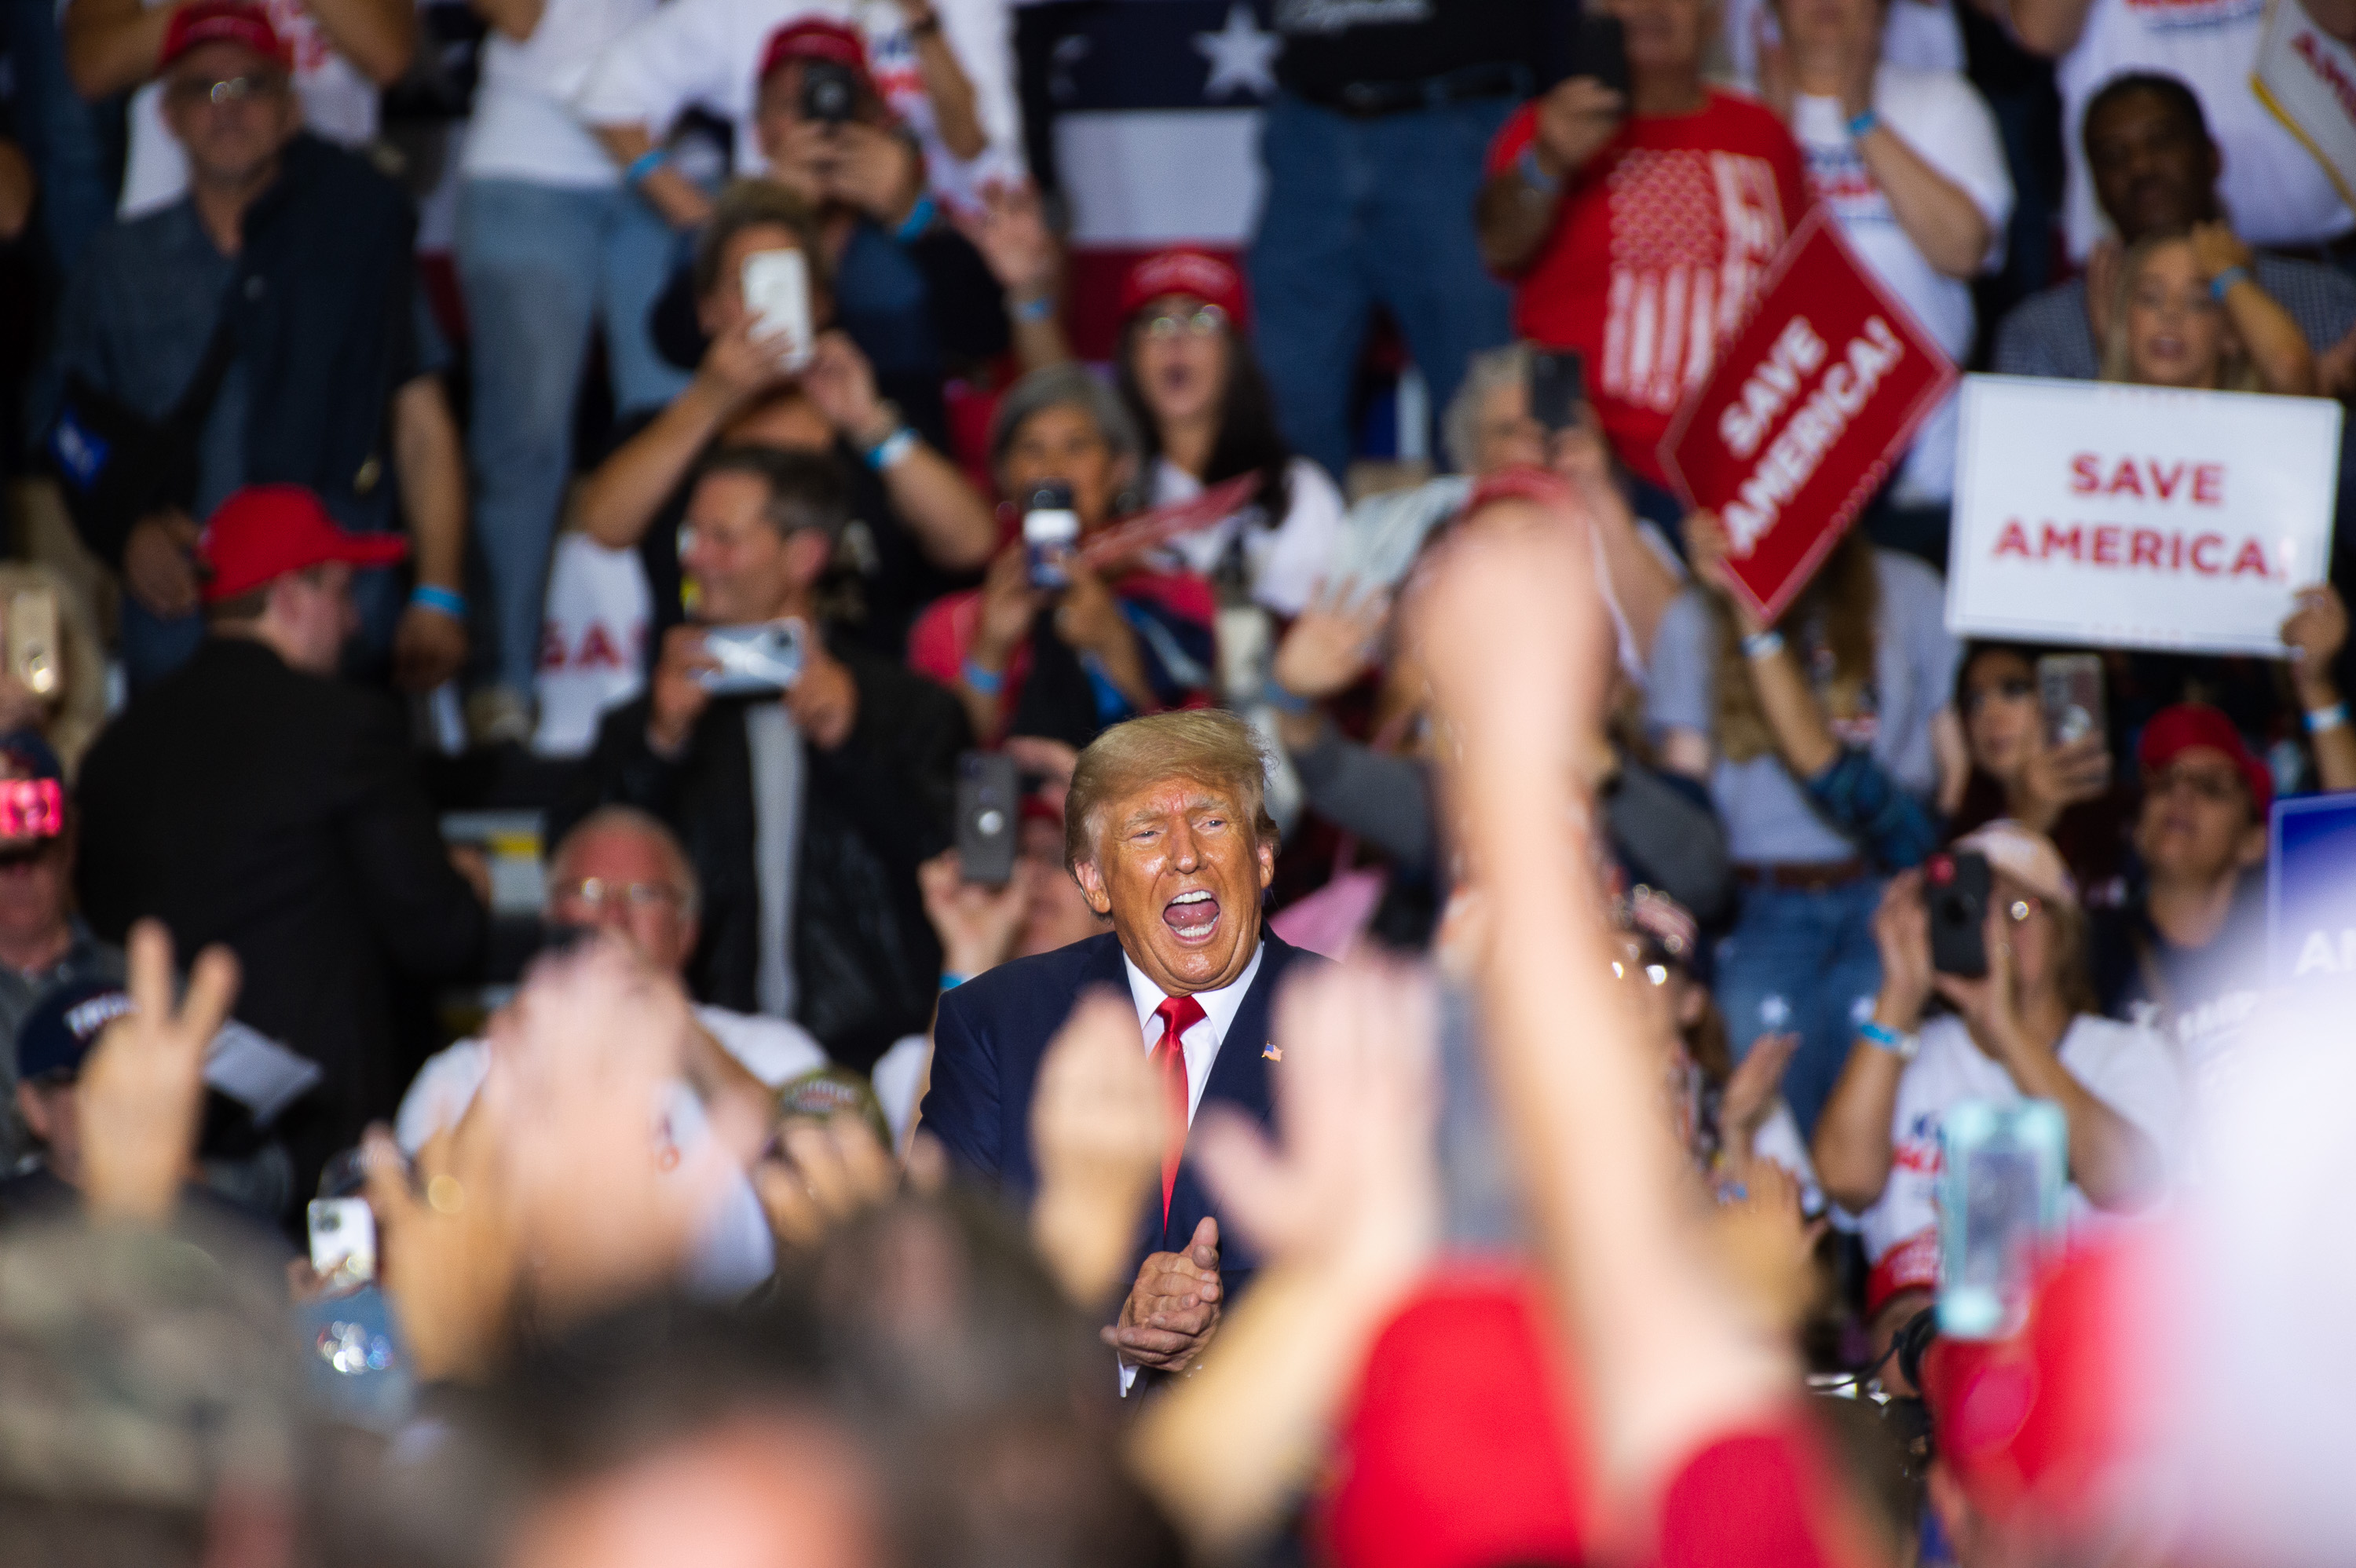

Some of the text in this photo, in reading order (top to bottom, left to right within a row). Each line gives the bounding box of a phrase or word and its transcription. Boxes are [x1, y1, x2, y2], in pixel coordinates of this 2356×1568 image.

[1720, 315, 1827, 459] SAVE
[1723, 316, 1906, 561] AMERICA!
[2069, 453, 2226, 507] SAVE
